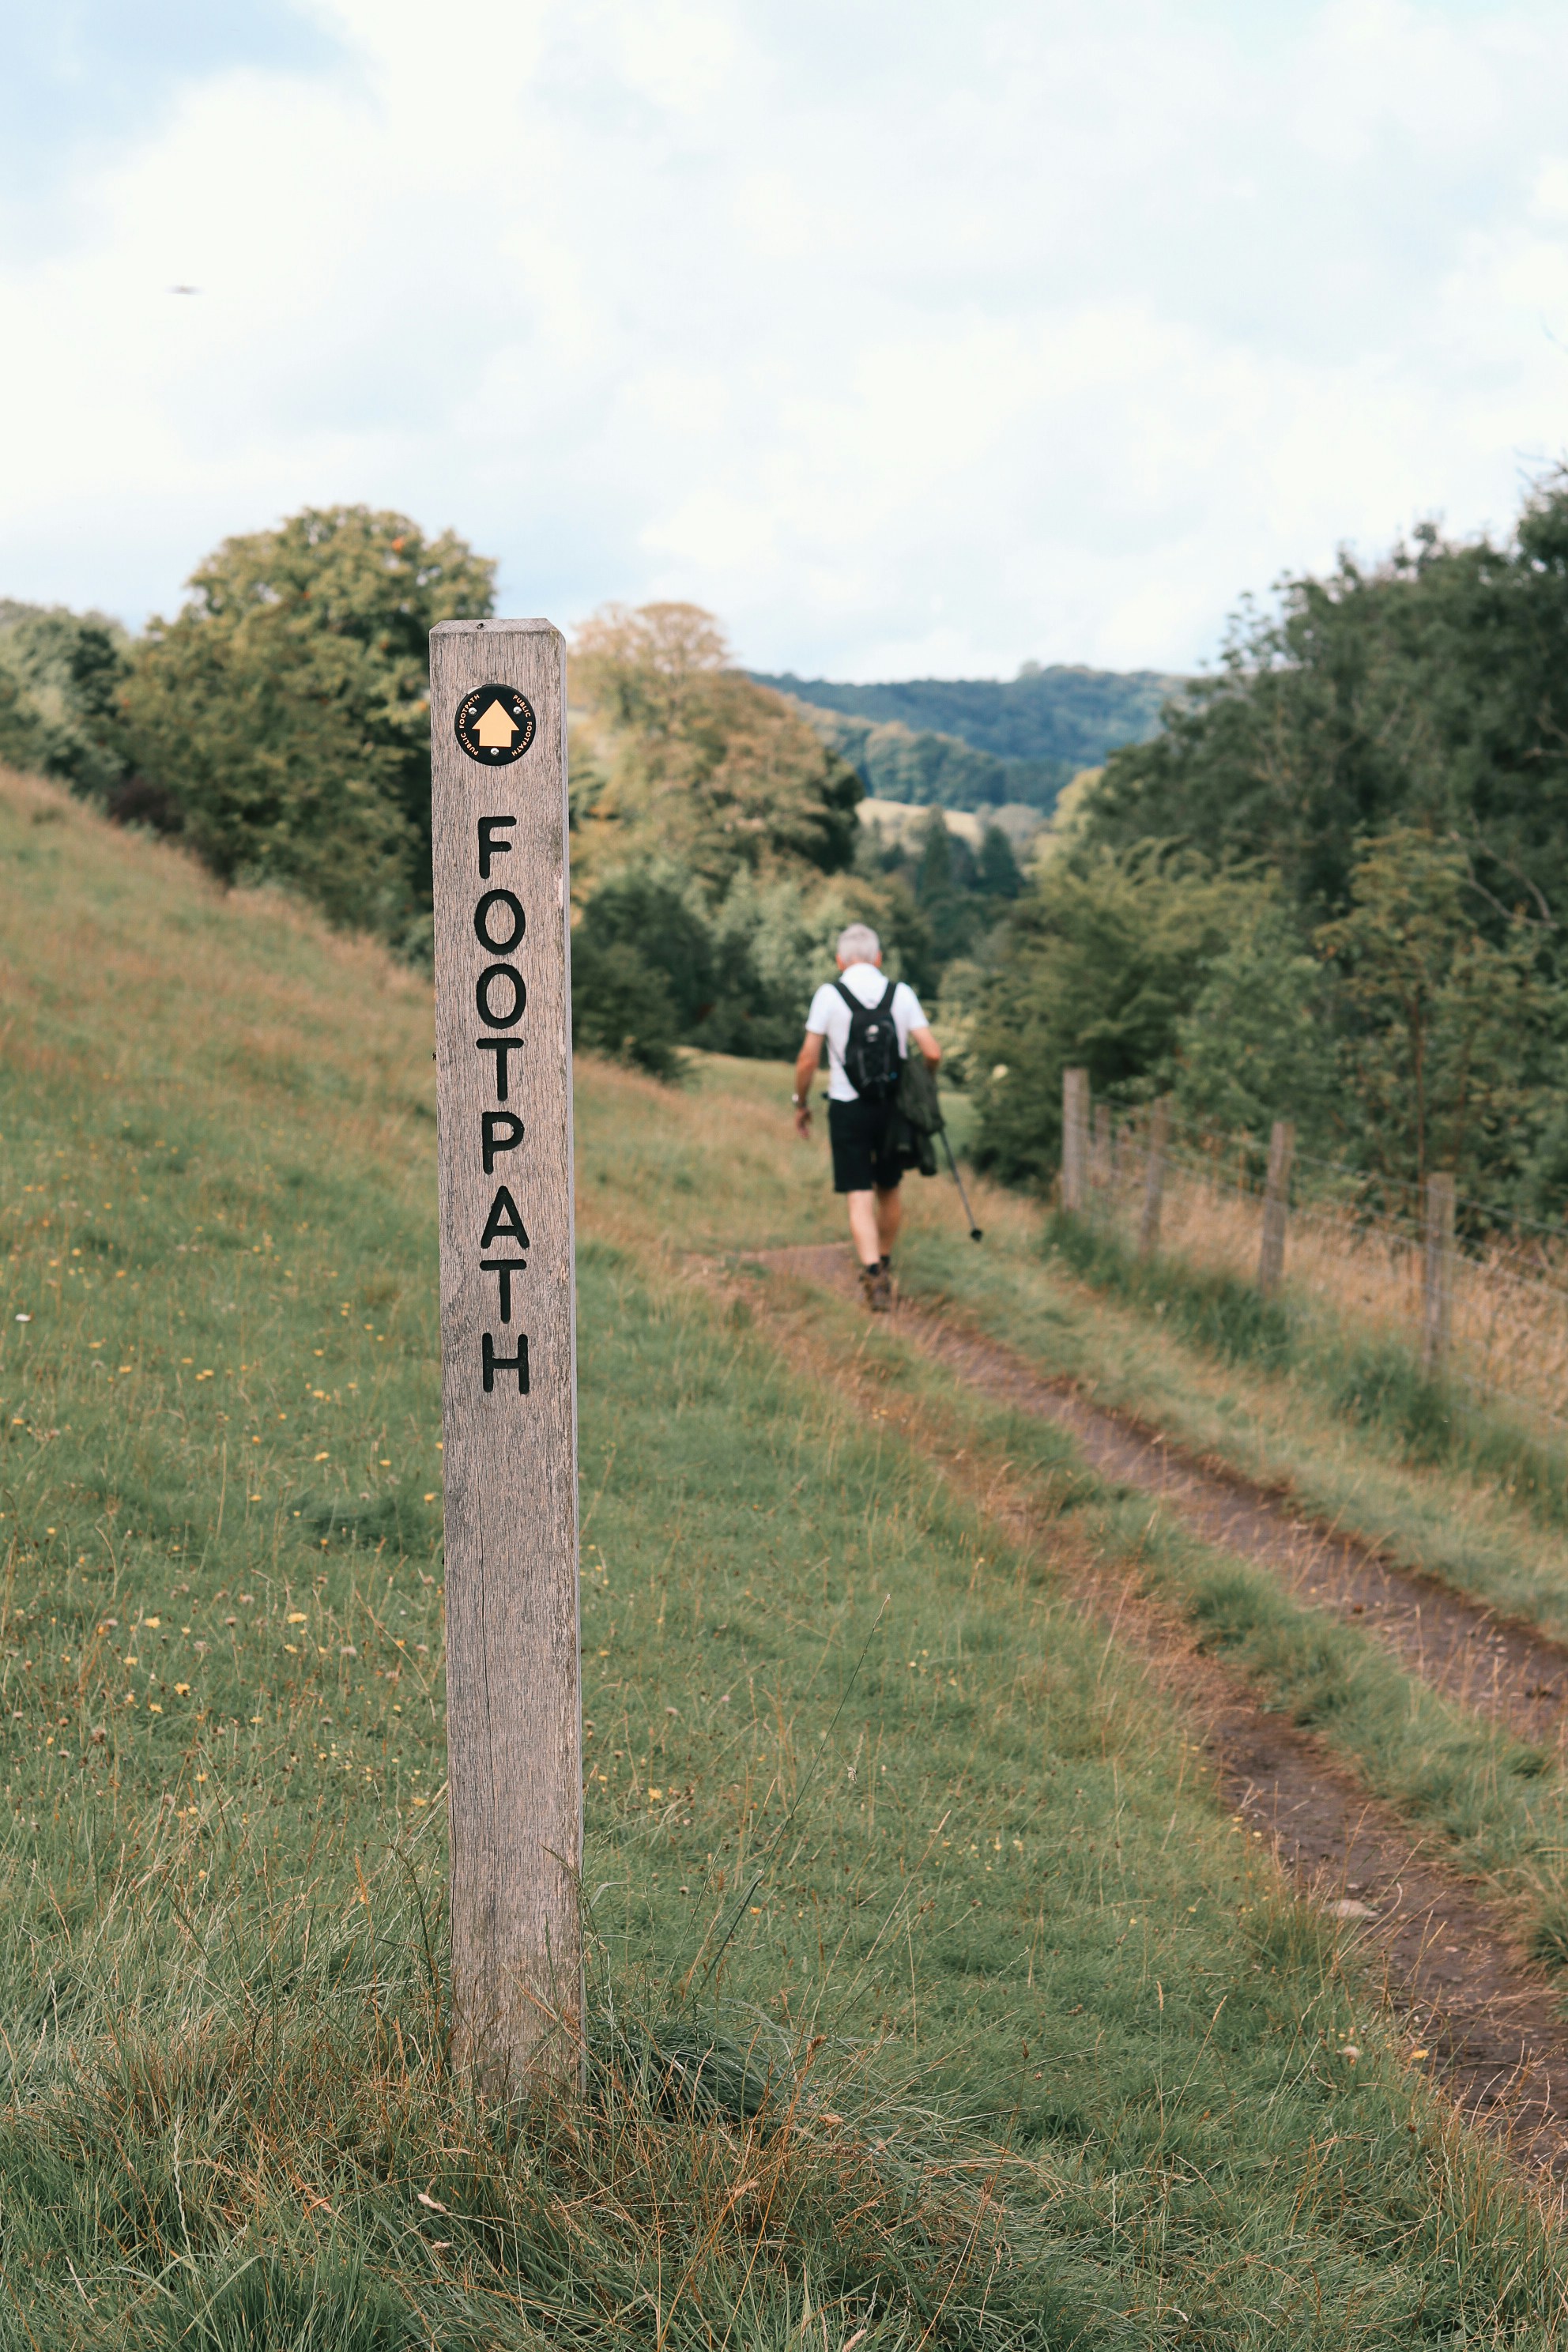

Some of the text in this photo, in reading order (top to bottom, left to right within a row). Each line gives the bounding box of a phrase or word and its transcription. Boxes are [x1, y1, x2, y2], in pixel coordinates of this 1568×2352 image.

[459, 694, 481, 756] PUBLIC FOOTPATH
[511, 695, 533, 756] PUBLIC FOOTPATH
[474, 816, 530, 1395] FOOTPATH
